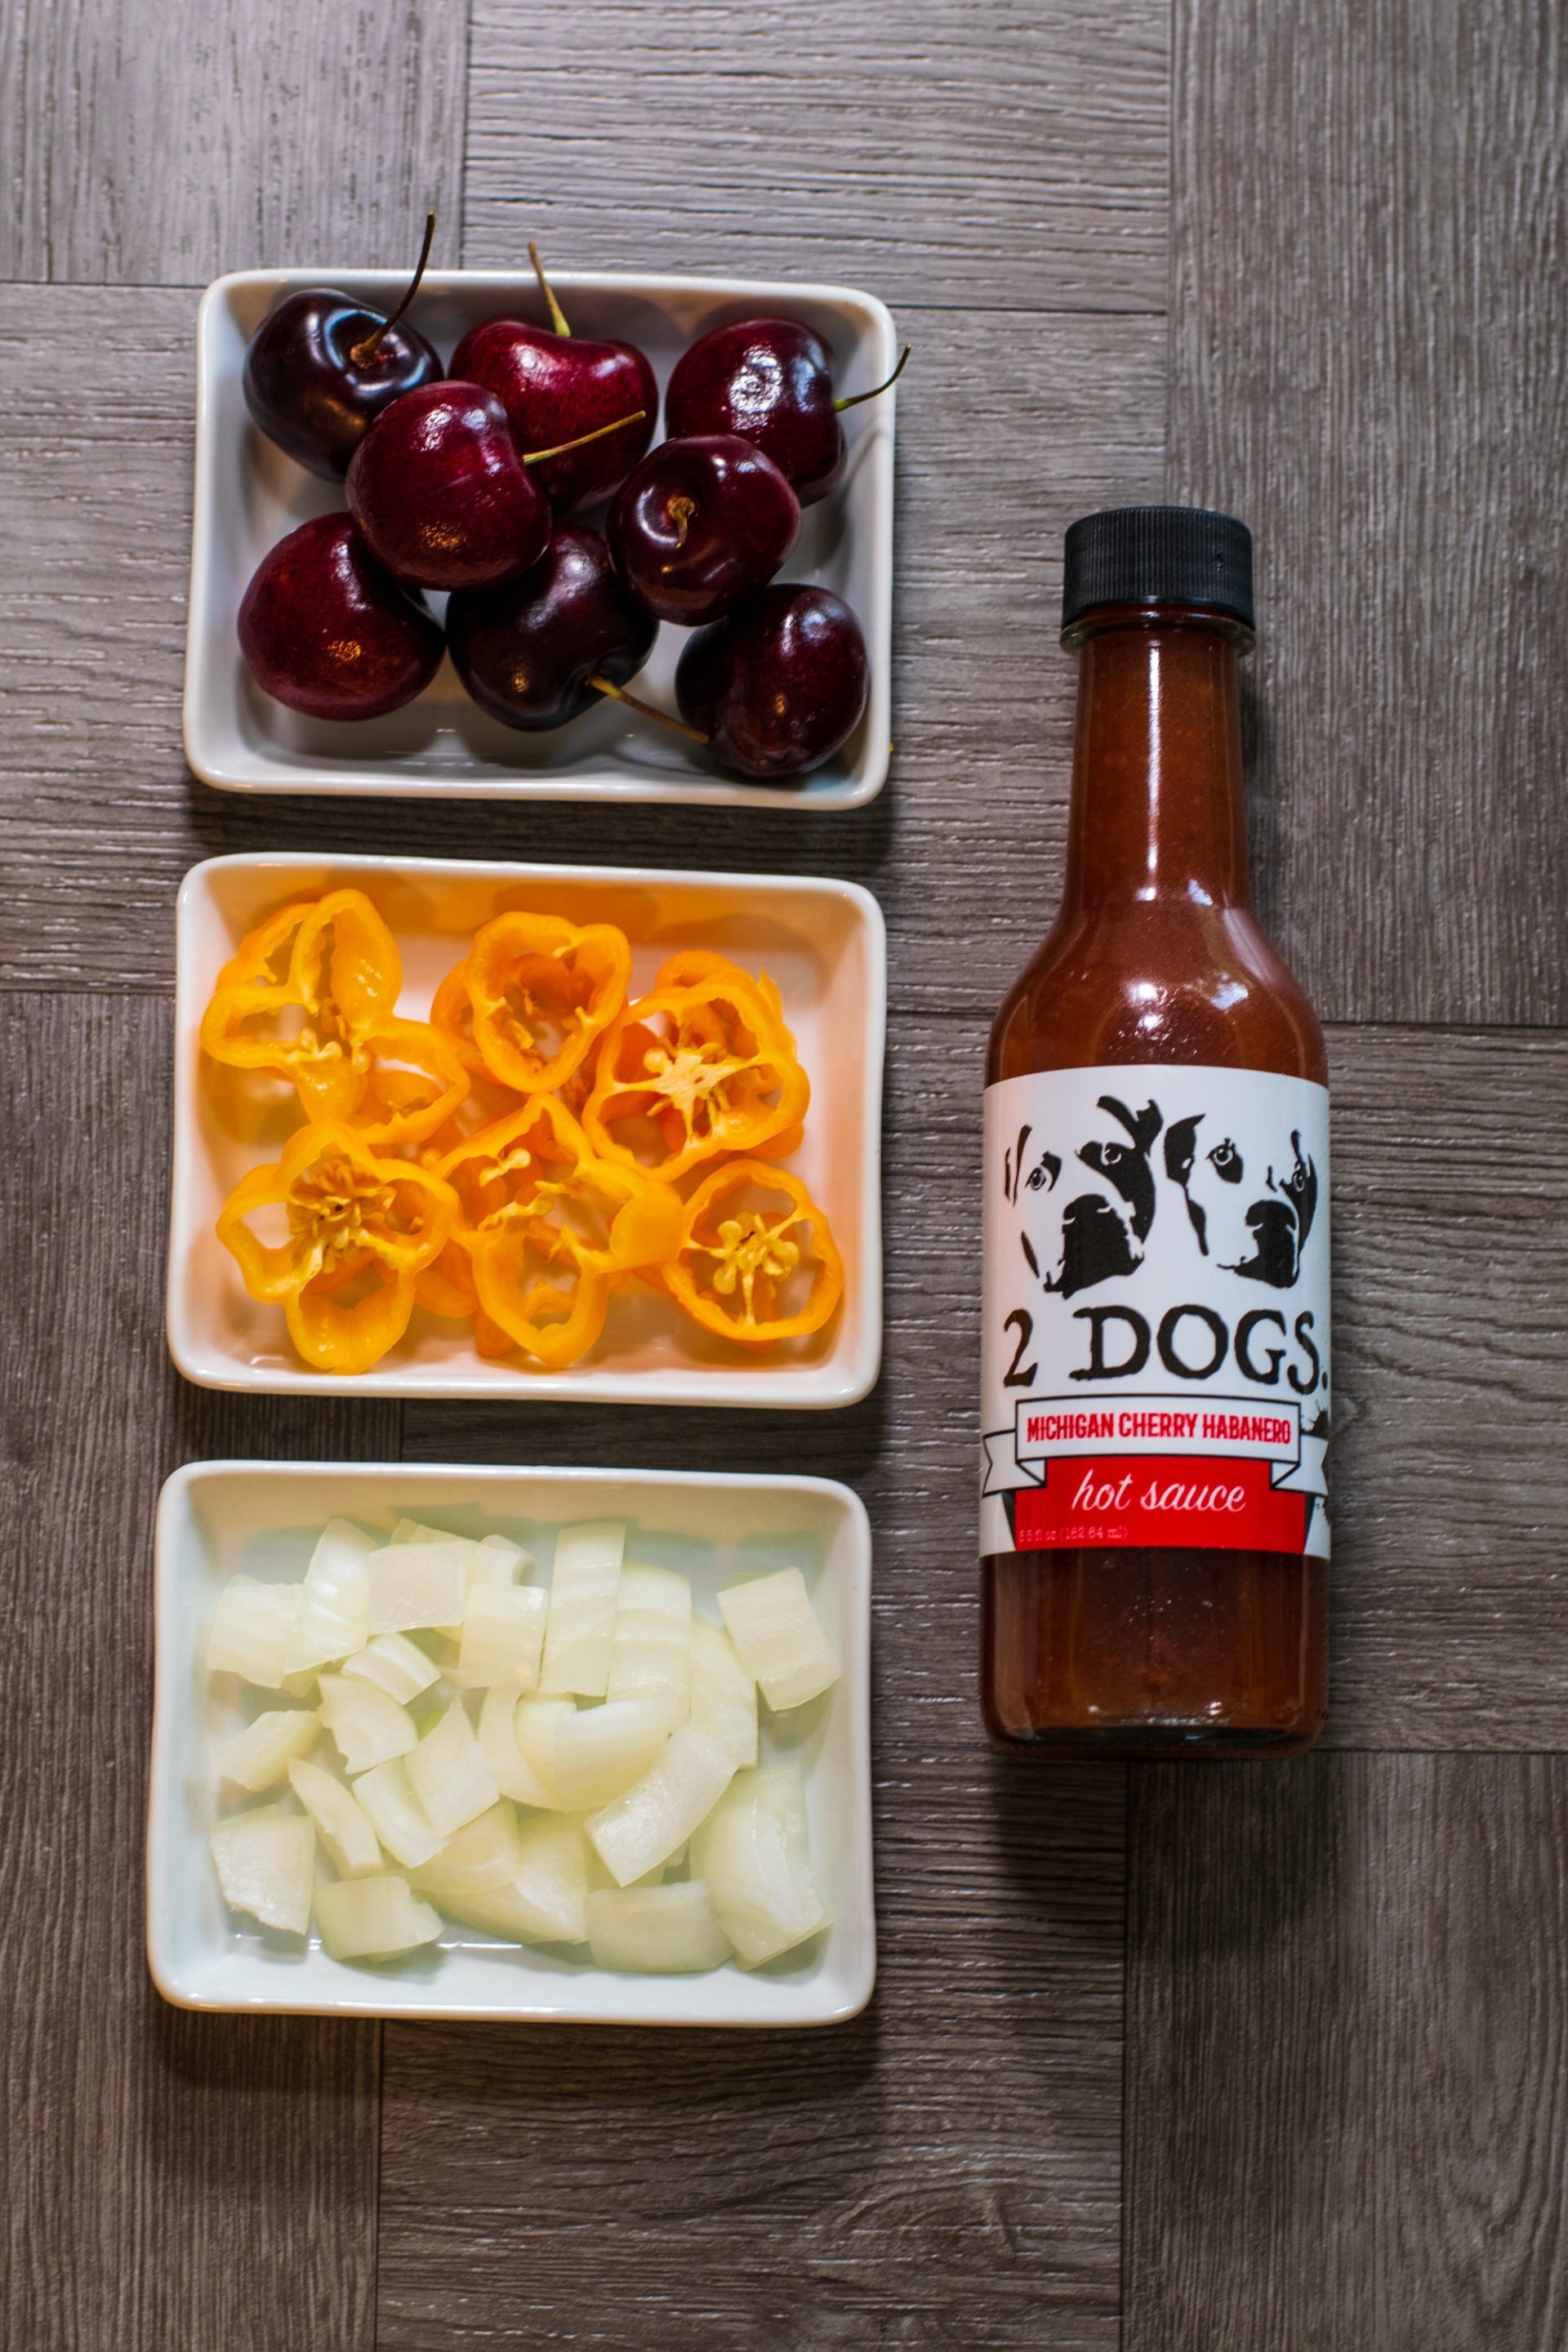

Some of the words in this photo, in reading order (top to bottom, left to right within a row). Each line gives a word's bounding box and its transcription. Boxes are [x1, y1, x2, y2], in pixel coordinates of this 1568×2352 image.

[1003, 1308, 1038, 1388] 2
[1026, 1412, 1116, 1443] MICHIGAN
[1117, 1411, 1199, 1439] CHERRY
[1201, 1413, 1292, 1446] HABANERO
[1071, 1468, 1134, 1511] hot
[1140, 1481, 1246, 1512] sauce
